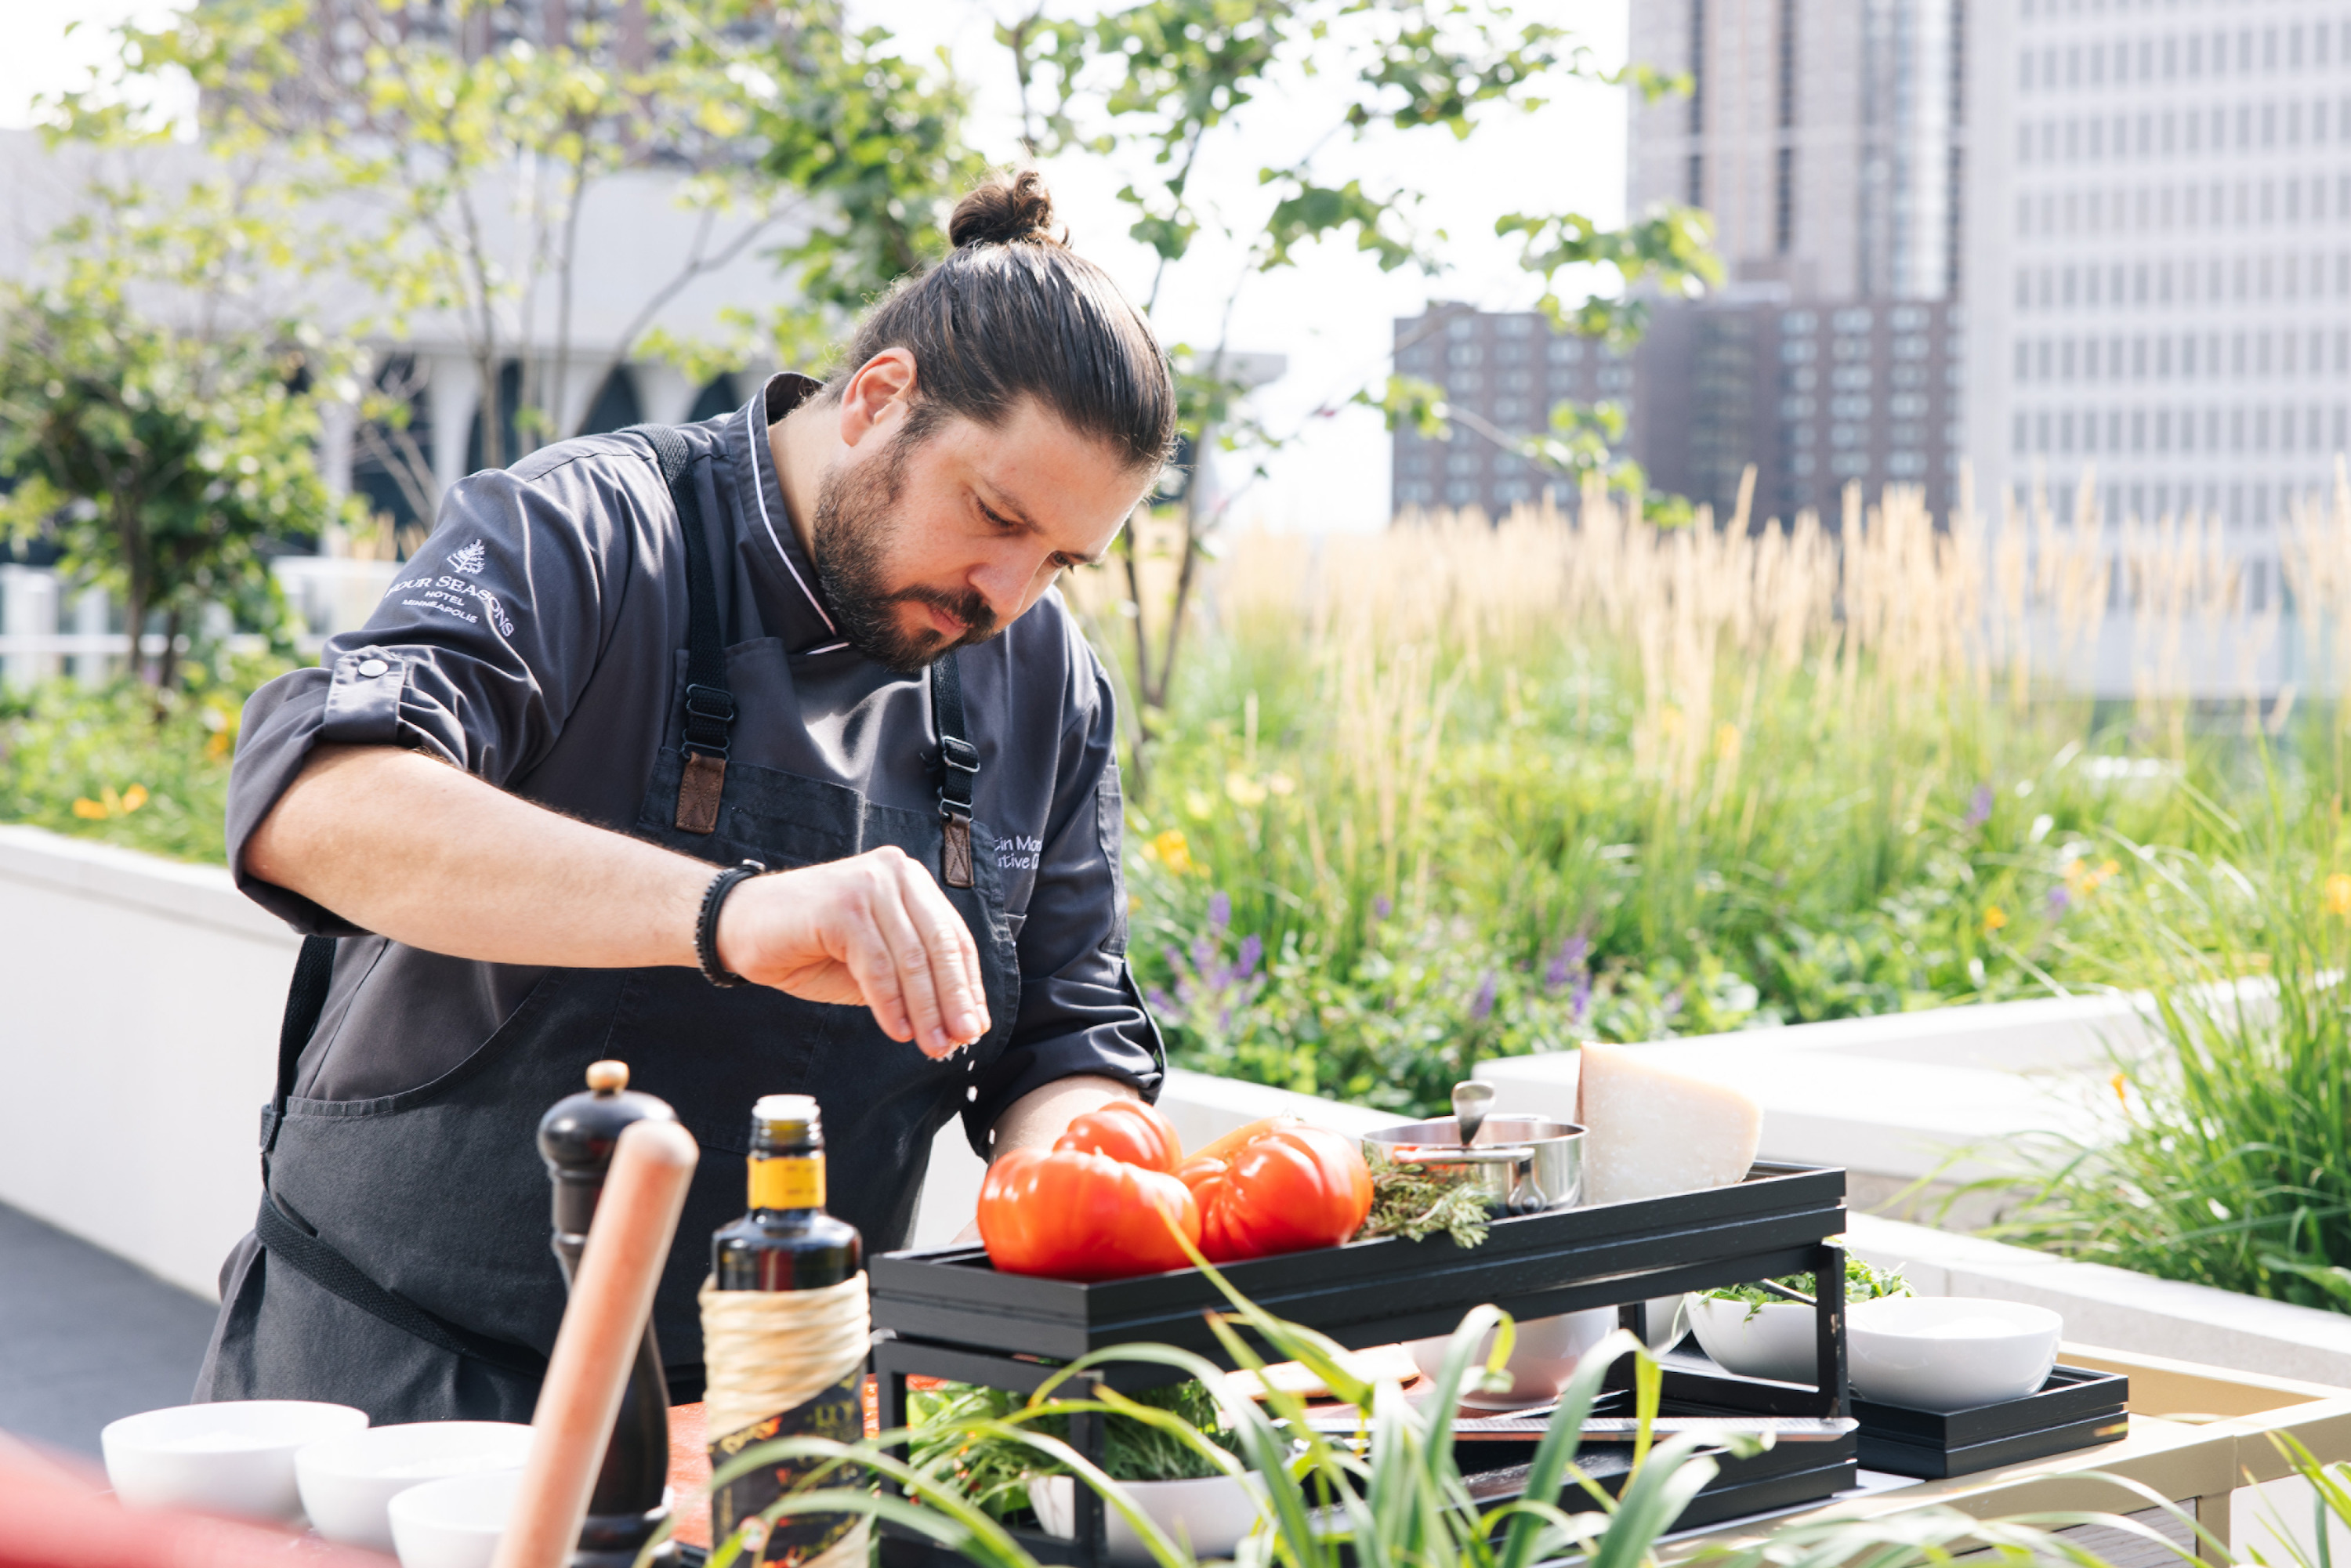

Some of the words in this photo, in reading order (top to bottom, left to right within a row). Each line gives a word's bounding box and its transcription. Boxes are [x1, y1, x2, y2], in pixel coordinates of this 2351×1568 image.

[424, 590, 465, 607] HOTEL
[435, 576, 515, 637] SEASONS
[402, 599, 479, 624] MINNEAPOLIS
